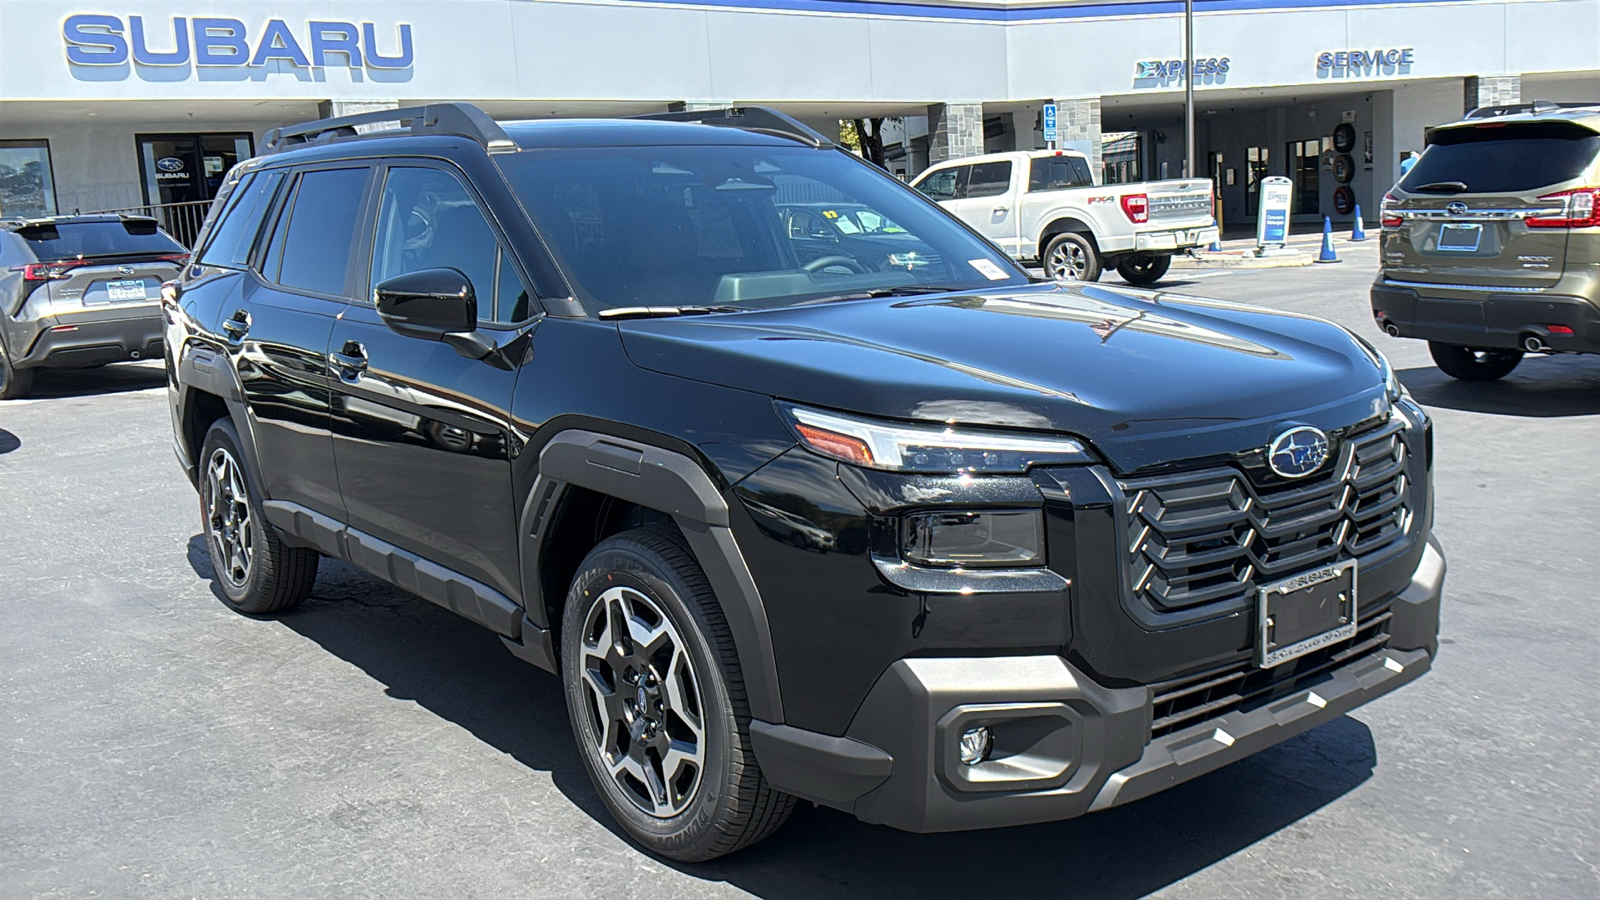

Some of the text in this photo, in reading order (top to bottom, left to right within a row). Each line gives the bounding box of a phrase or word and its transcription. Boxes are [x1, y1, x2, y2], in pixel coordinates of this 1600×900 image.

[63, 14, 414, 67] SUBARU
[1317, 48, 1415, 68] SERVICE
[1088, 196, 1115, 205] FX4
